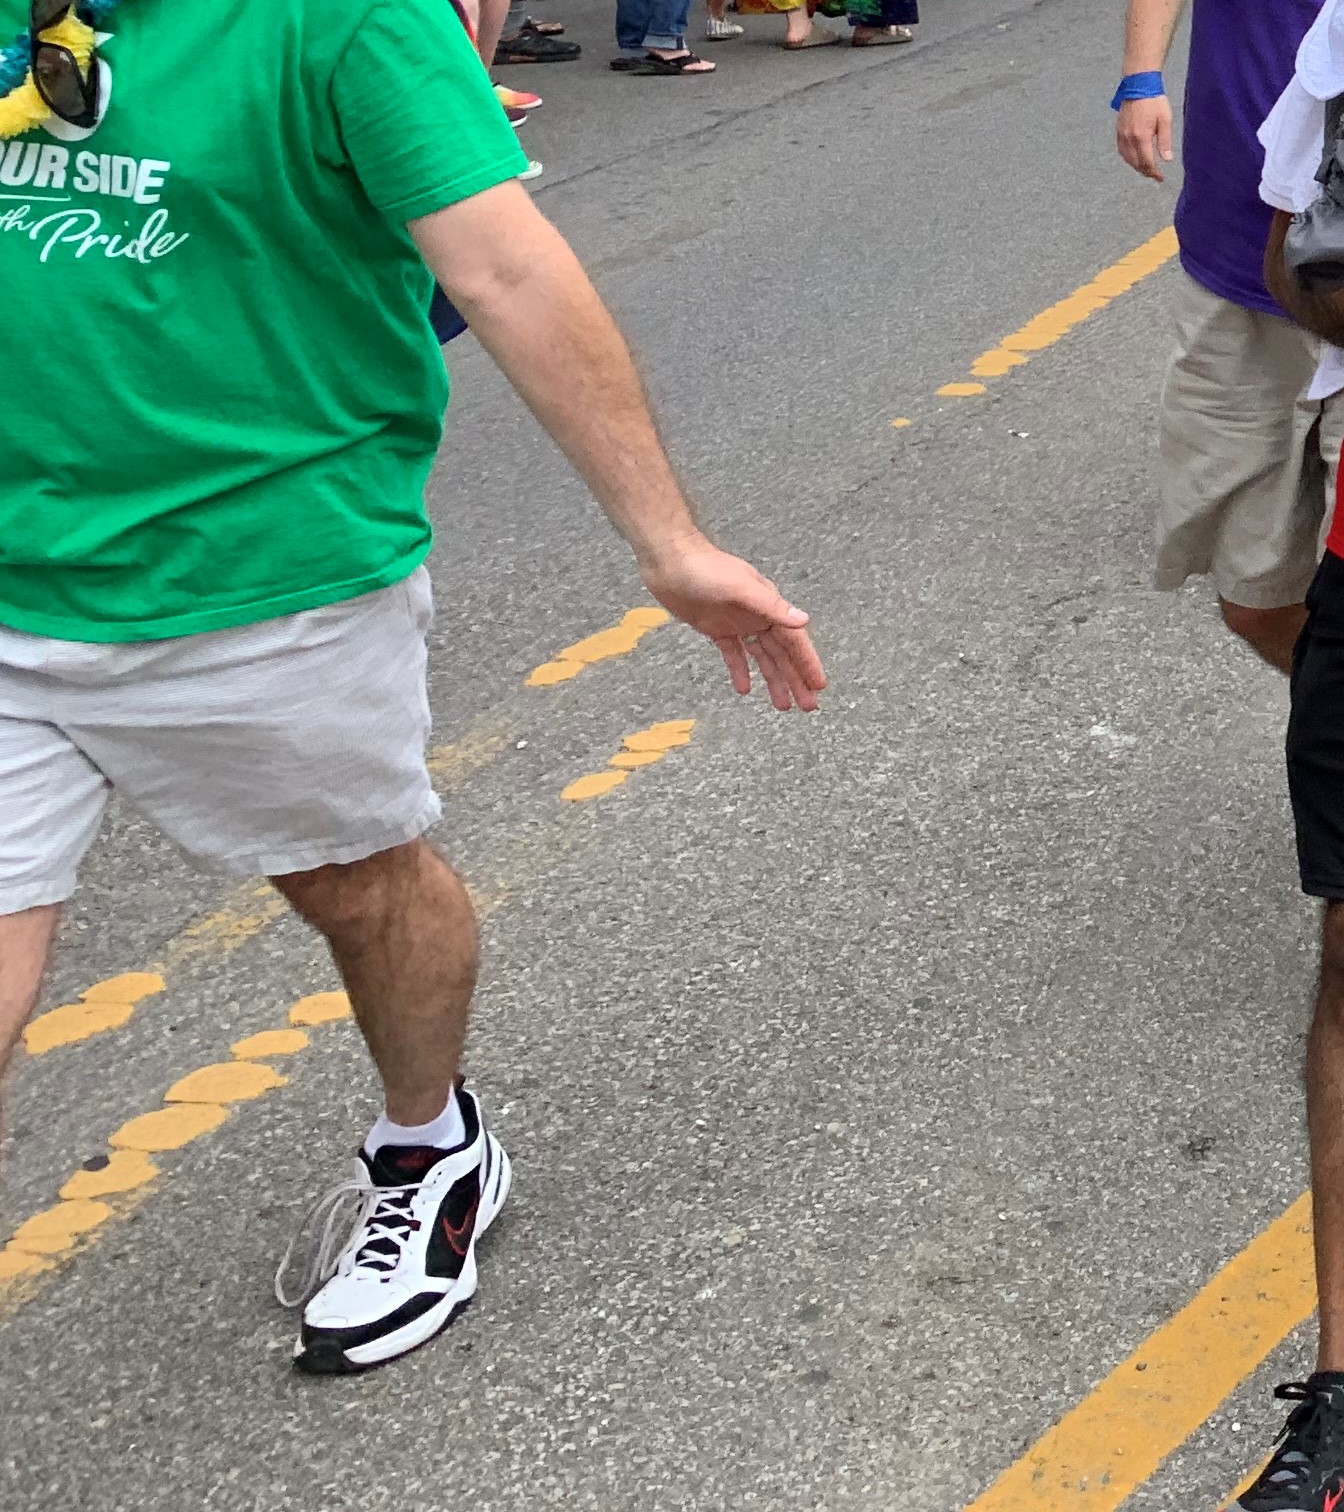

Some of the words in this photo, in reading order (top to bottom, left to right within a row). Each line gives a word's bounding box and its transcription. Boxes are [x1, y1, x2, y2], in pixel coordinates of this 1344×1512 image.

[0, 140, 70, 189] UR
[72, 149, 171, 205] SIDE
[29, 208, 189, 264] Pride
